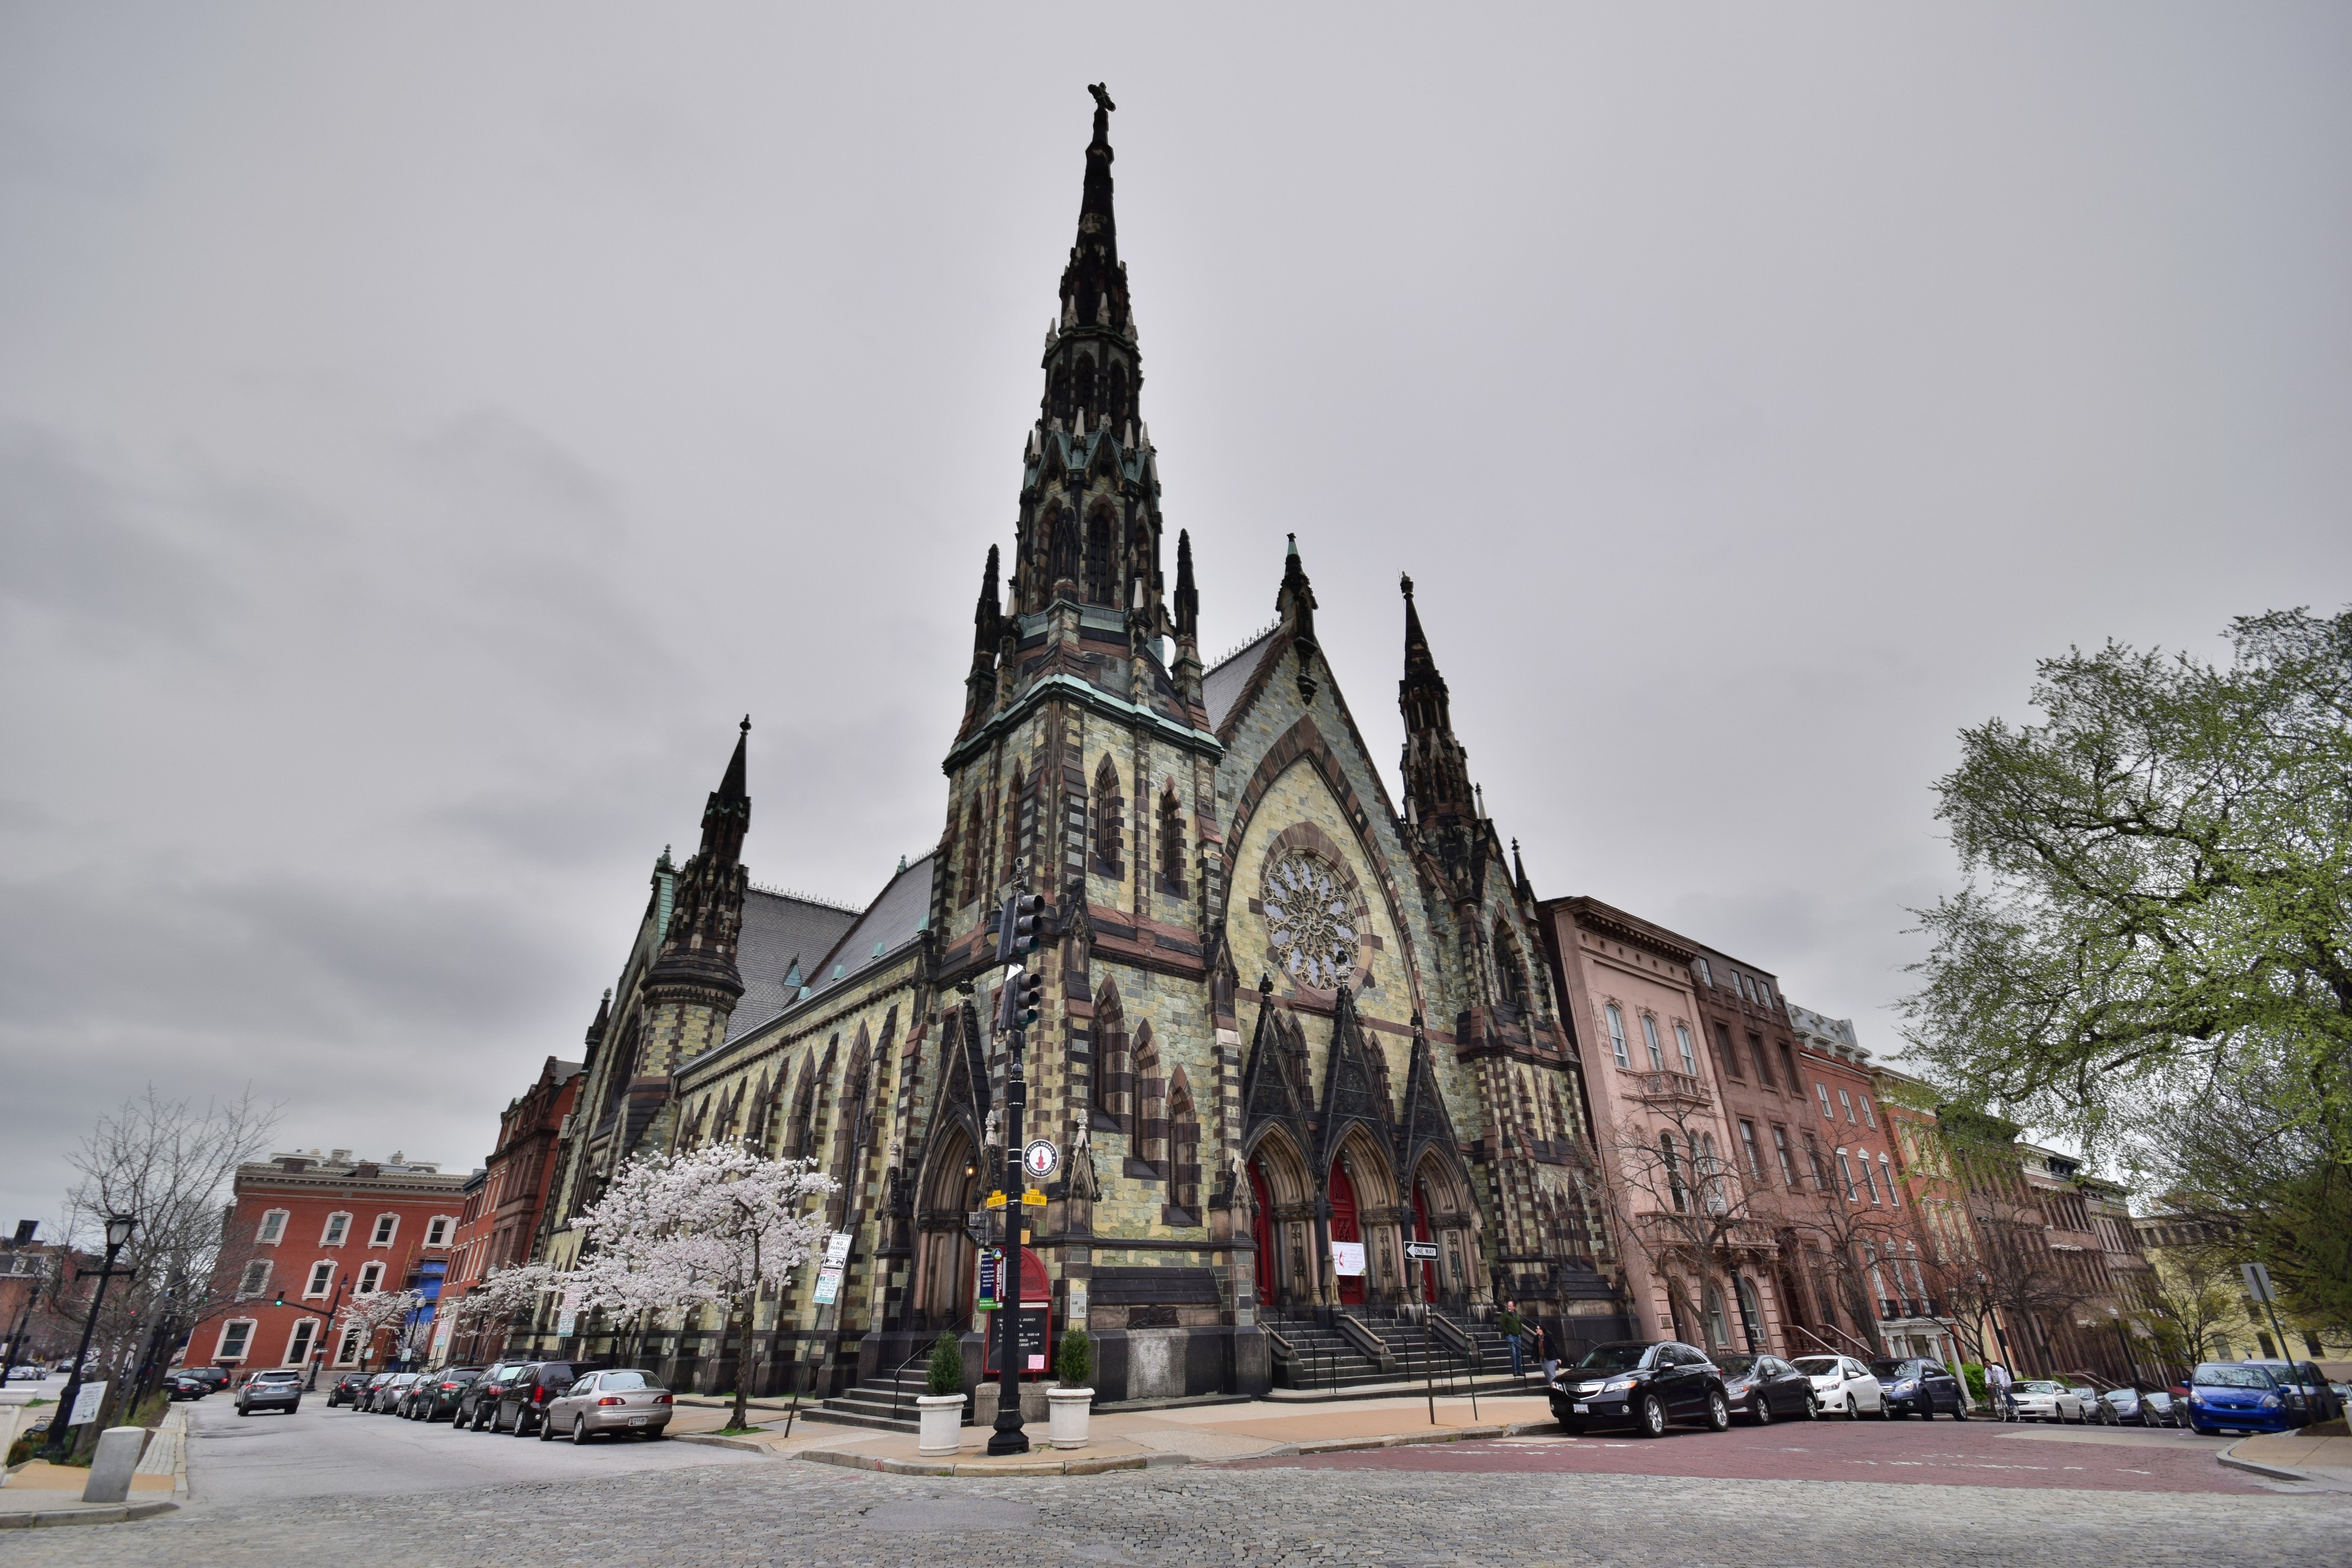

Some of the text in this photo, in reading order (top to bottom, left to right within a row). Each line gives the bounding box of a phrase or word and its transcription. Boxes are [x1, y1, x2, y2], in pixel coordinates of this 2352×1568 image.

[1027, 1143, 1055, 1154] MOUNT VERNON
[1026, 1162, 1055, 1175] HISTORIC DISTRICT
